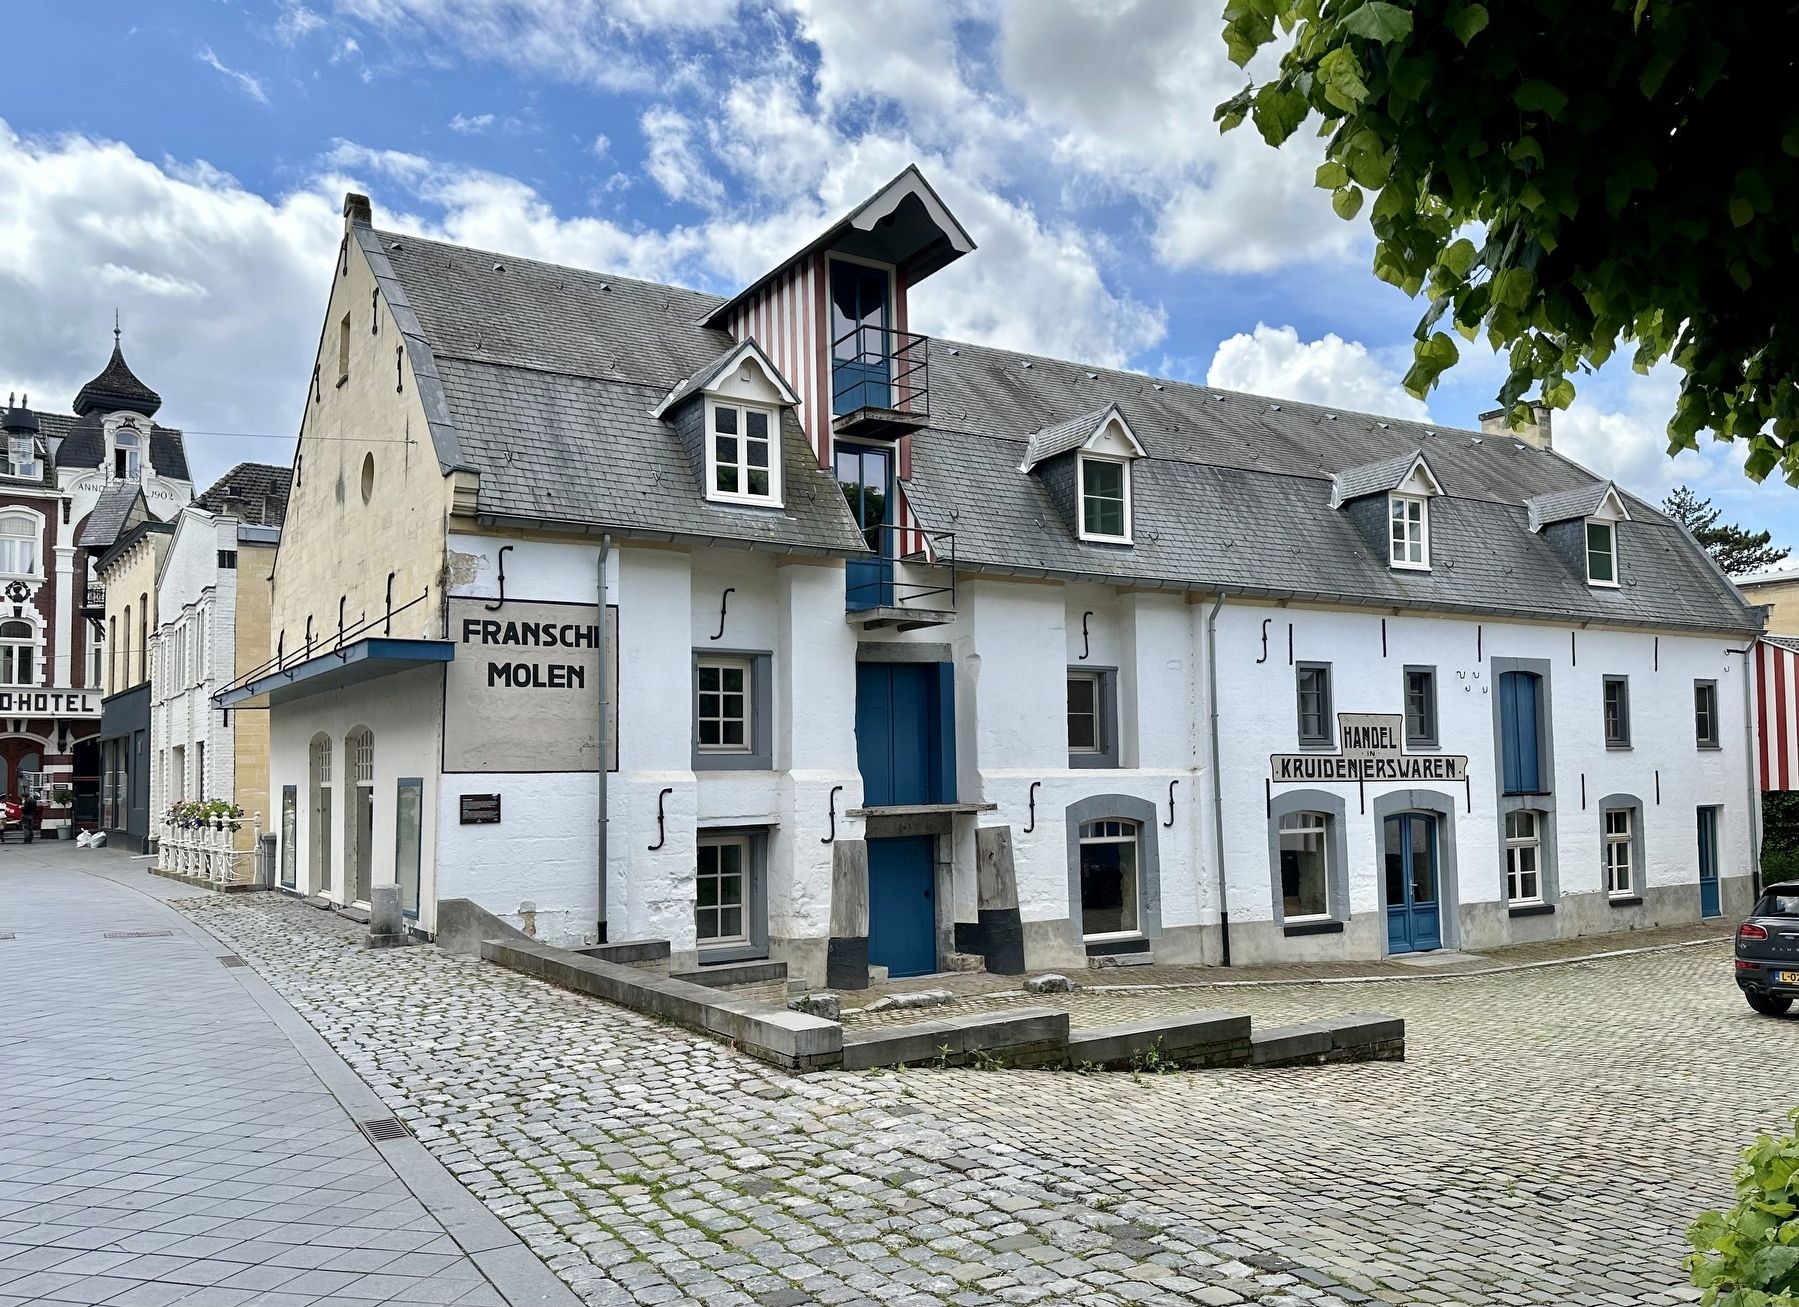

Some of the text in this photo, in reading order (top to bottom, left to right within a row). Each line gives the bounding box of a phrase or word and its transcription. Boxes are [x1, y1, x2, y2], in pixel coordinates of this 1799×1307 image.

[487, 661, 585, 689] MOLEN
[1344, 726, 1397, 749] HANDEL
[1281, 758, 1456, 779] KRUIDENIERSWAREN
